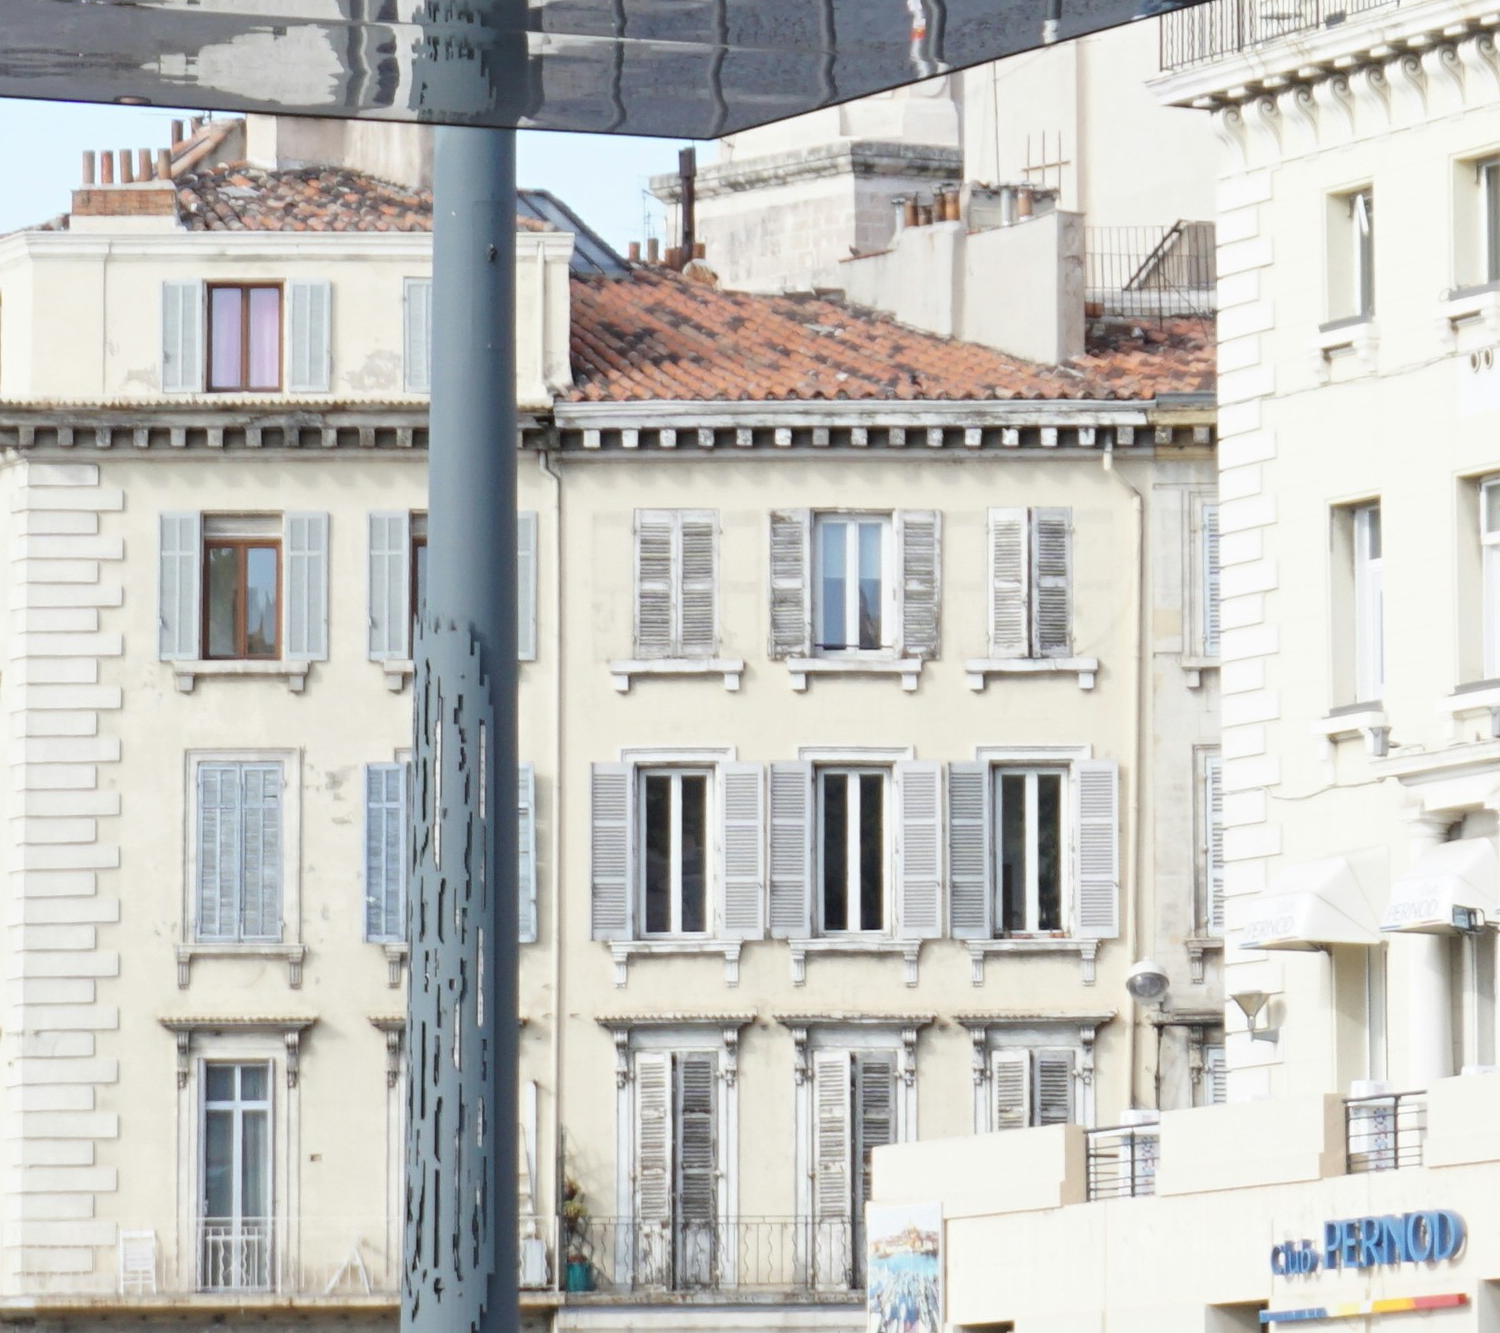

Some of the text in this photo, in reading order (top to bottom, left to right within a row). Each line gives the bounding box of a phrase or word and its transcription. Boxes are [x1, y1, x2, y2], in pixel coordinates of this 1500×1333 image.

[1386, 899, 1439, 923] PERNOD
[1271, 1209, 1468, 1276] Club PERNOD
